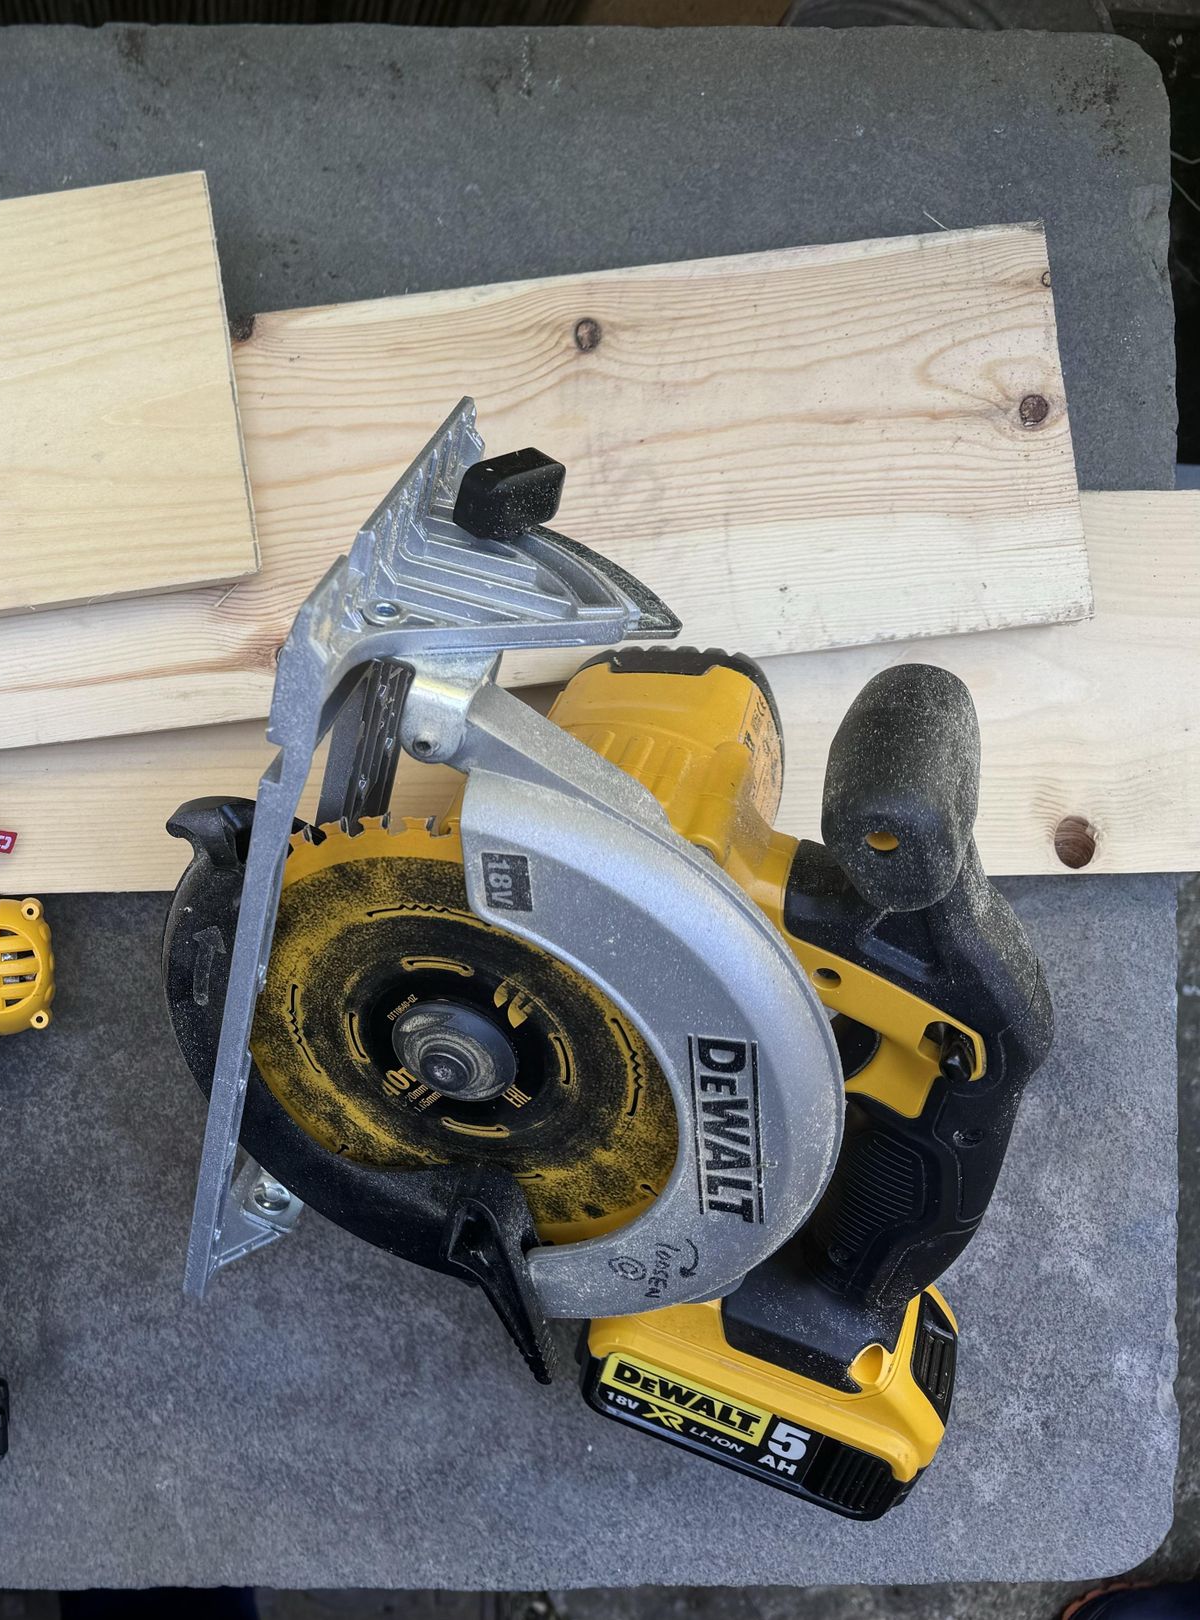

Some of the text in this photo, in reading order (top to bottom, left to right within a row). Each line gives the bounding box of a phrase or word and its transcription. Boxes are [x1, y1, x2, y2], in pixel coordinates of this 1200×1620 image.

[488, 859, 513, 908] 18V
[697, 1037, 755, 1224] DEWALT
[605, 1391, 745, 1453] 18V XR LI-ION
[613, 1362, 762, 1436] DEWALT
[758, 1455, 798, 1476] AH
[767, 1421, 811, 1461] 5
